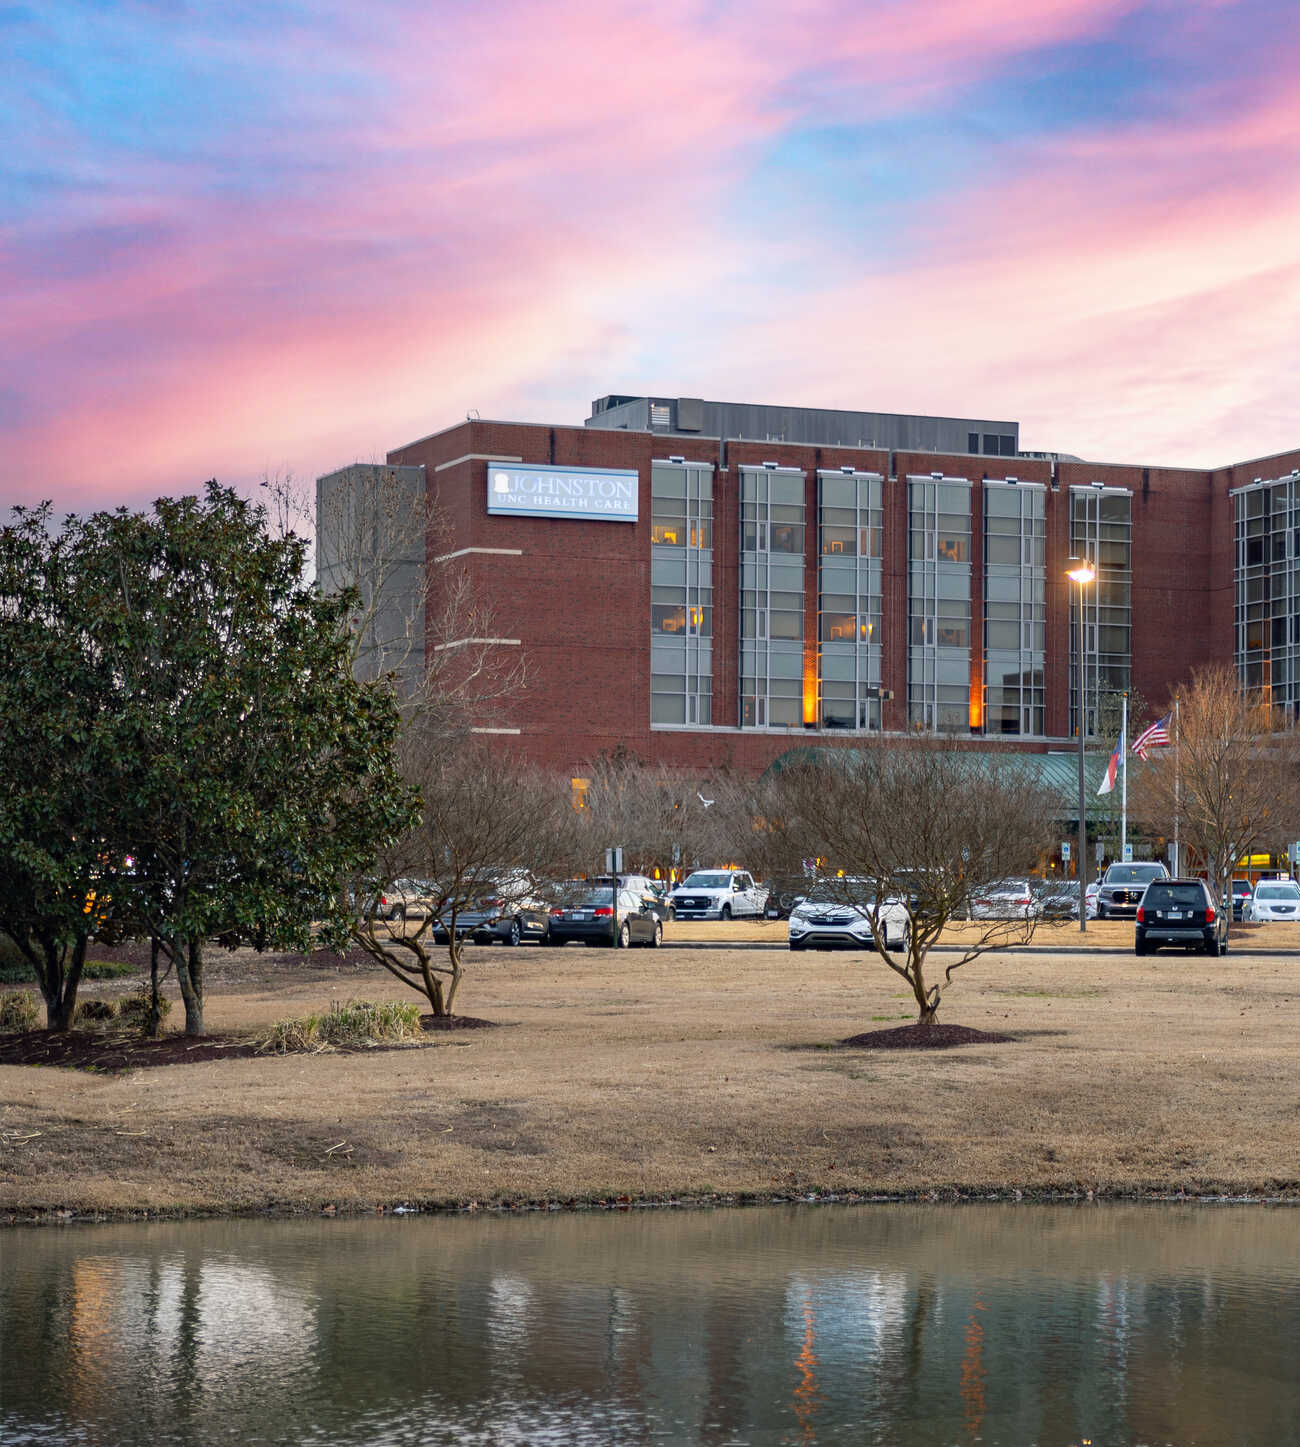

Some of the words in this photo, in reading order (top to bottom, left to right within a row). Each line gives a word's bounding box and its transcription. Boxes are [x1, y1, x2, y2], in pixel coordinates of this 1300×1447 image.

[510, 475, 633, 498] JOHNSTON
[497, 494, 527, 505] UNC
[534, 495, 588, 508] HEALTH
[595, 500, 632, 511] CARE
